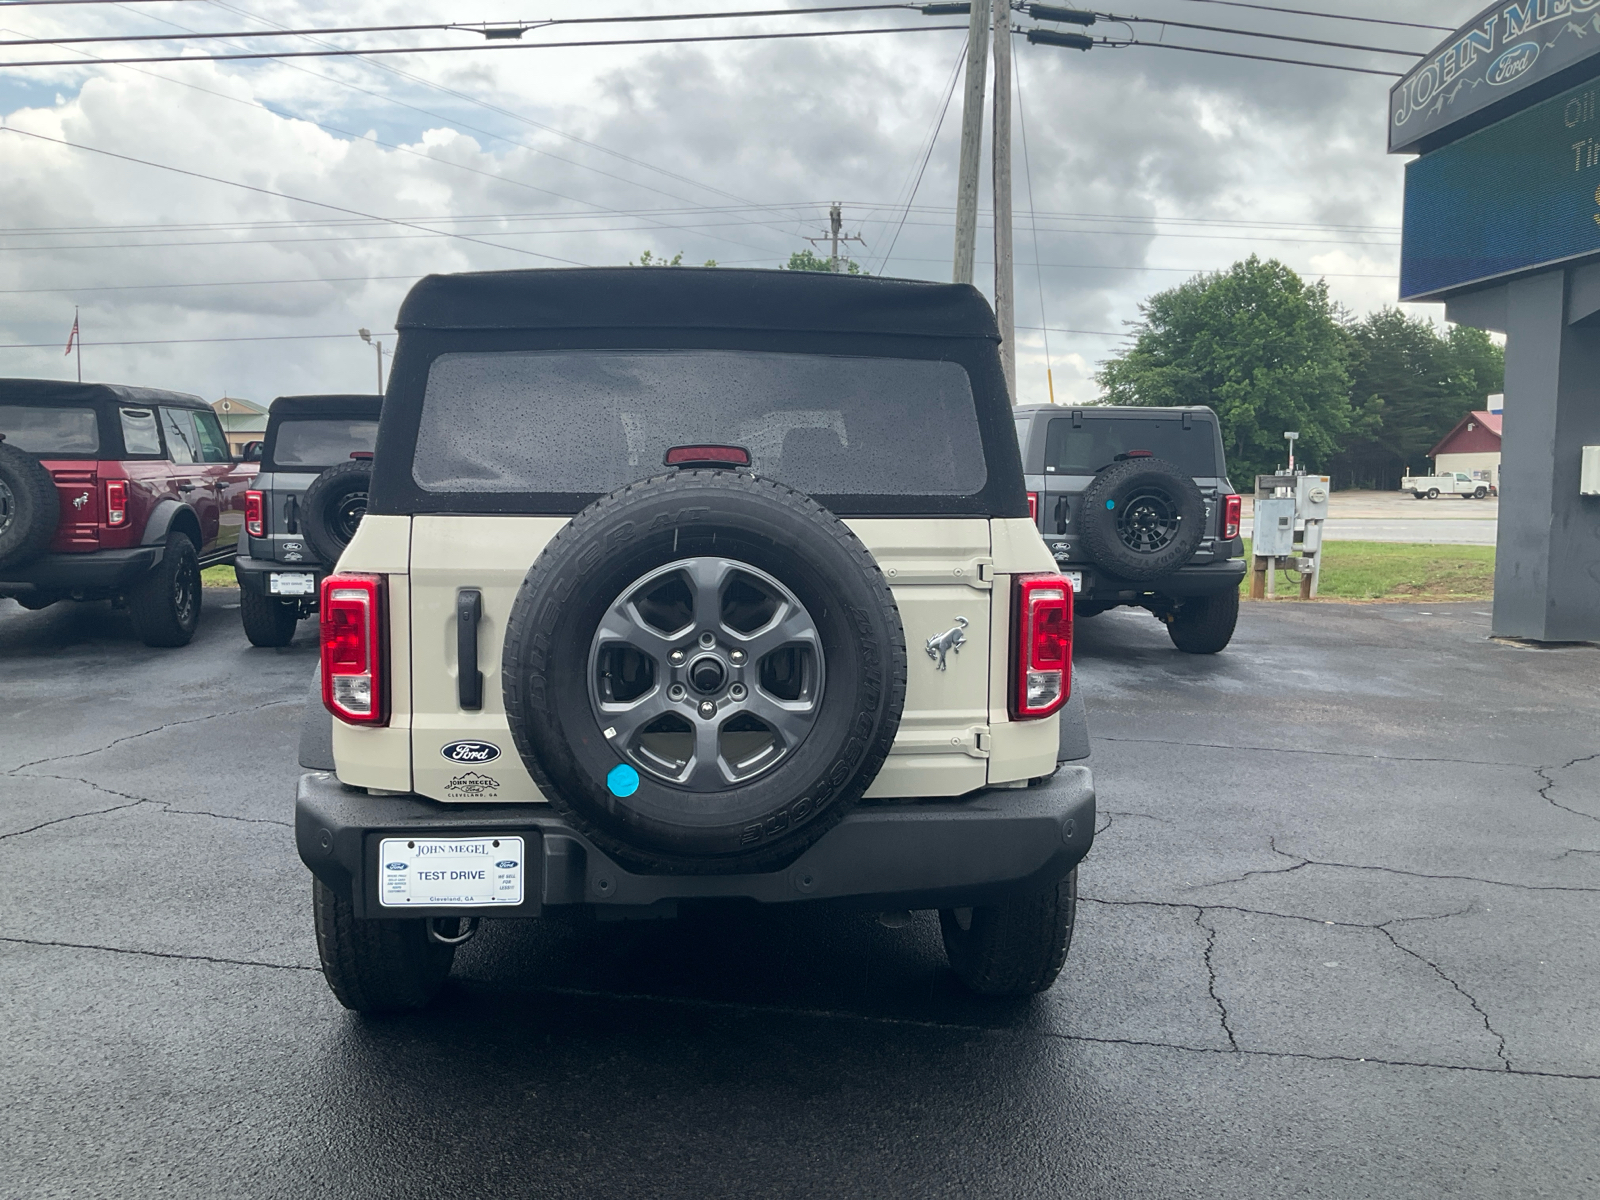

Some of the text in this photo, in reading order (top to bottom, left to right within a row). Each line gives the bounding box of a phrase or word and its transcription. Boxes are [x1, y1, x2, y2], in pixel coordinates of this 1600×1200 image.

[1395, 14, 1498, 126] JOHN
[1495, 48, 1530, 82] Ford
[528, 505, 711, 712] DUELER A/T
[741, 604, 881, 846] BRIDGESTONE
[415, 844, 489, 857] JOHN MEGEL
[417, 870, 486, 881] TEST DRIVE
